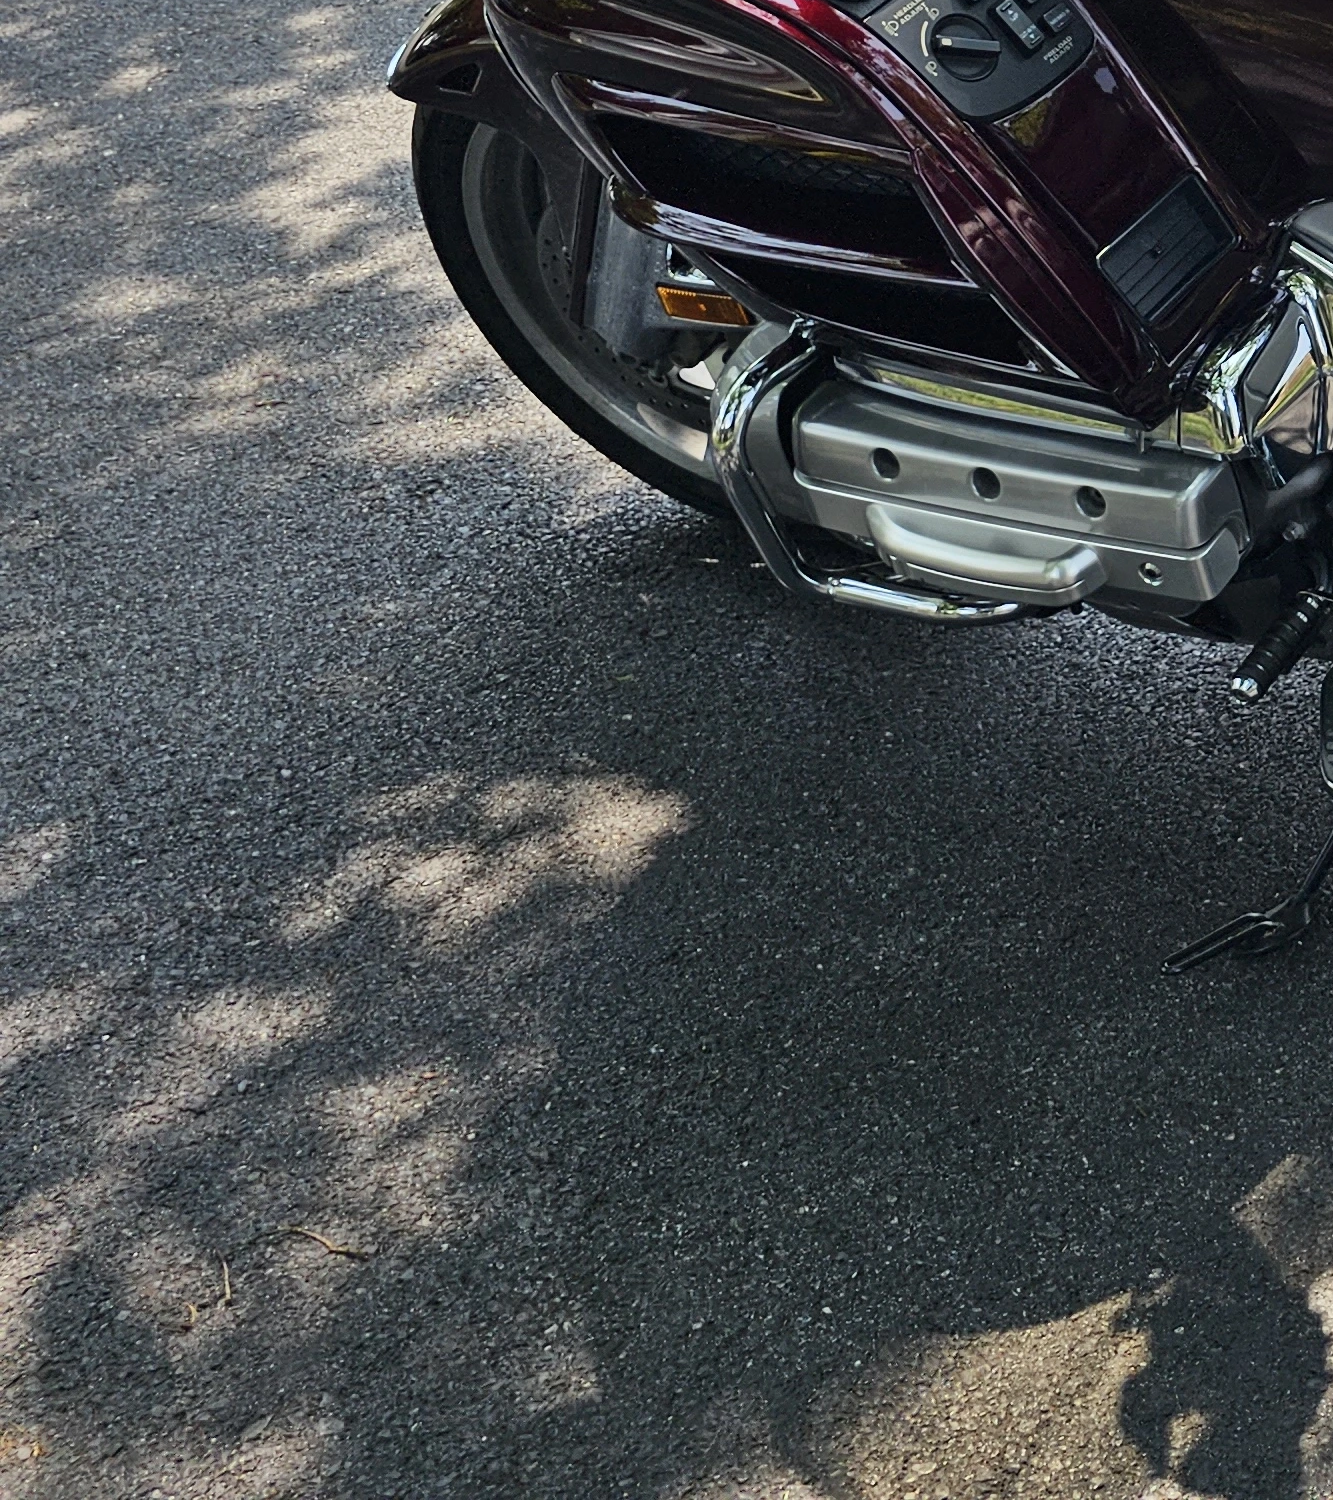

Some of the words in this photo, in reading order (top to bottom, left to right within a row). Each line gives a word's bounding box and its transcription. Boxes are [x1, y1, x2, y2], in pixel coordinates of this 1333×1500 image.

[900, 2, 926, 25] ADJUST
[1042, 35, 1073, 61] PRELOAD
[1049, 41, 1074, 65] ADJUST
